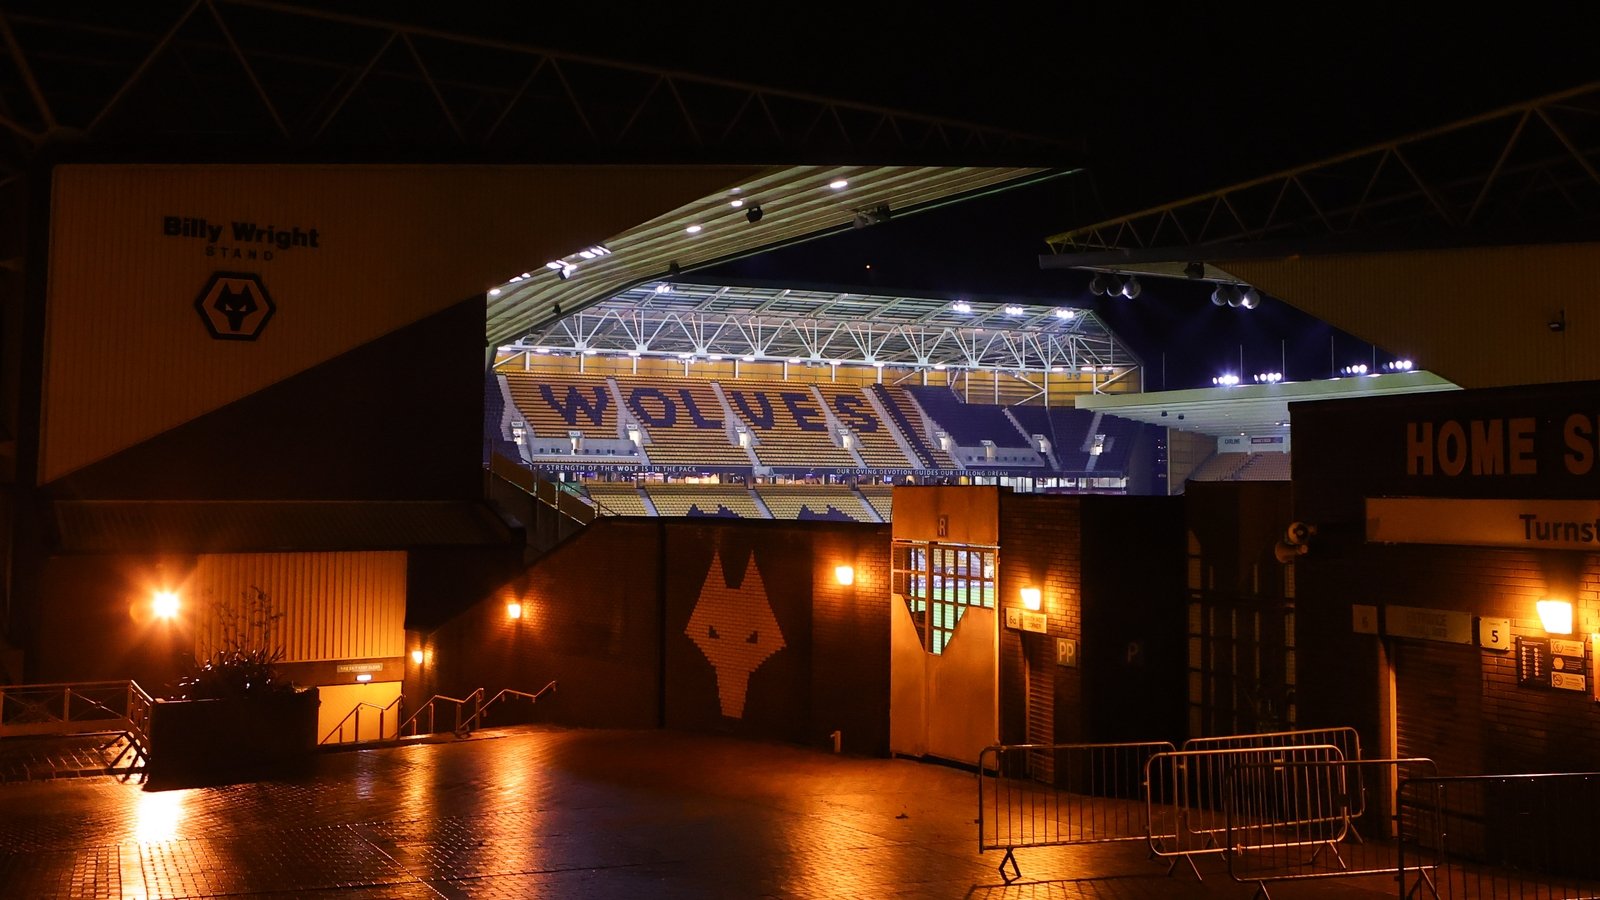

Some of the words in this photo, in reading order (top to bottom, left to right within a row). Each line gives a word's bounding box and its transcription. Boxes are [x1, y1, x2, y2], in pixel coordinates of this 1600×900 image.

[164, 216, 223, 243] Billy
[231, 222, 319, 250] Wright
[206, 246, 274, 261] STAND
[539, 384, 878, 433] WOLVES
[1407, 417, 1538, 477] HOME
[1563, 412, 1600, 476] S
[939, 517, 946, 537] R
[1491, 630, 1499, 643] 5
[1060, 641, 1074, 664] PP
